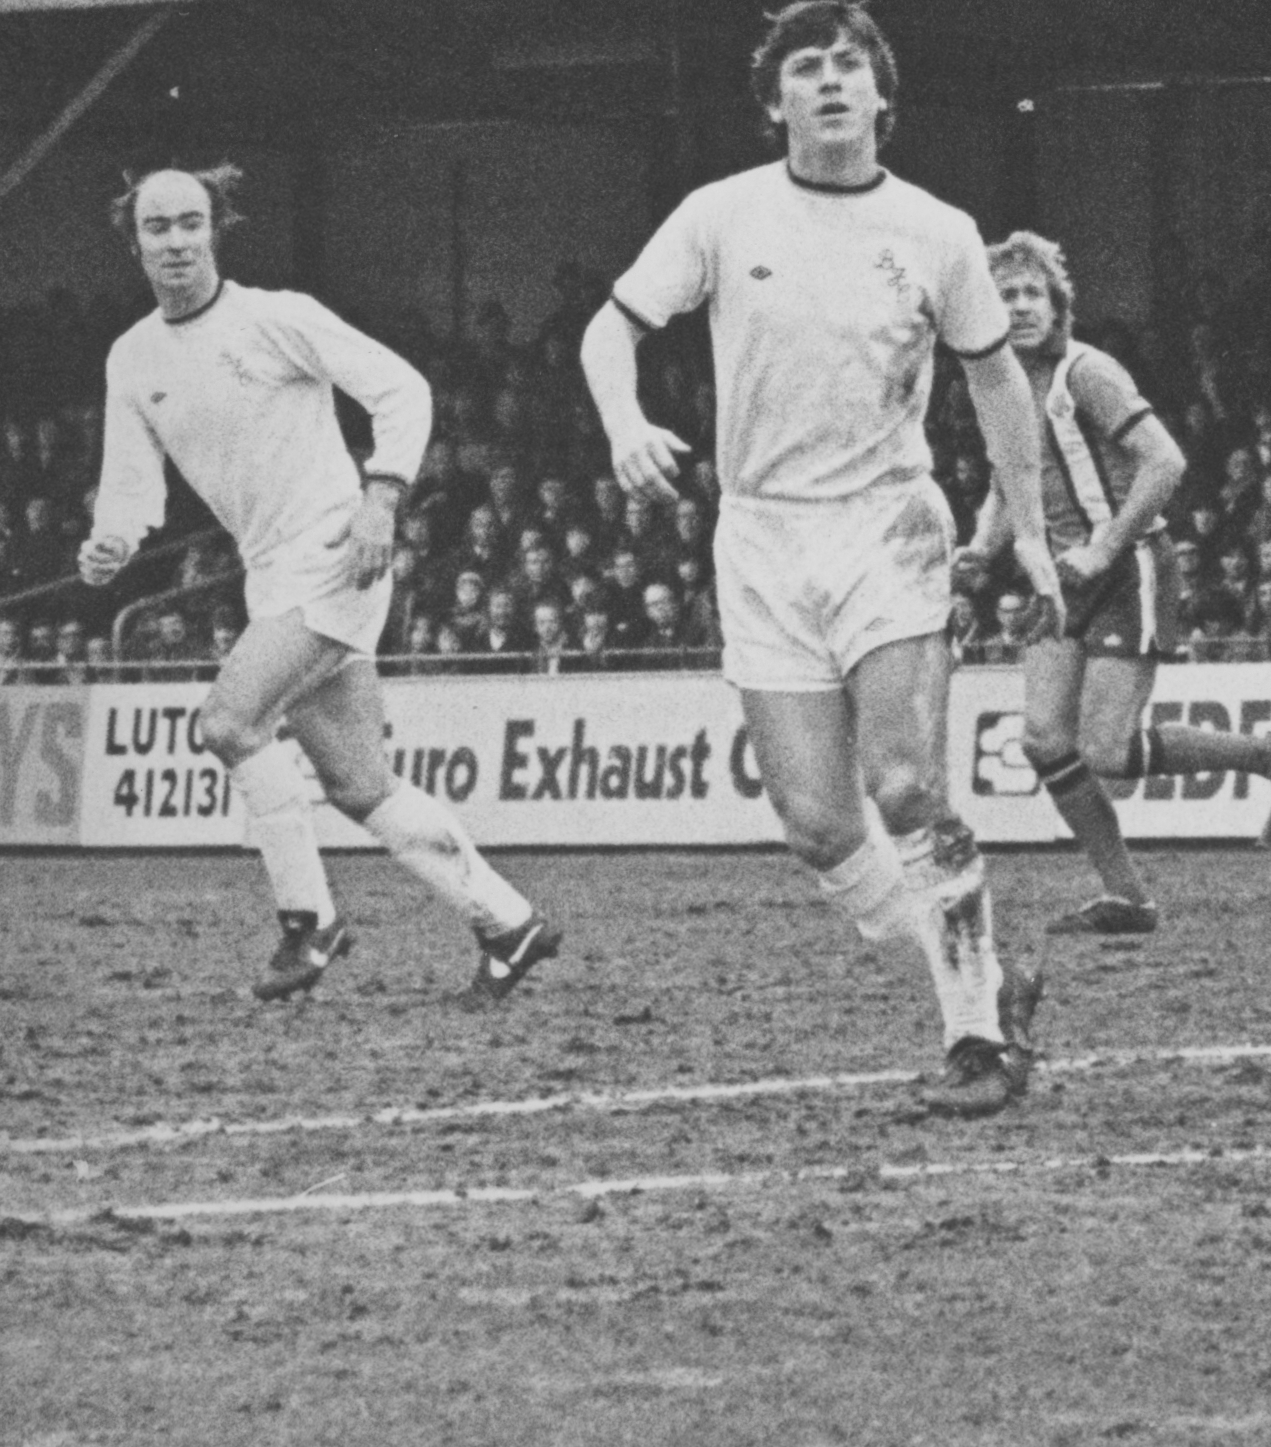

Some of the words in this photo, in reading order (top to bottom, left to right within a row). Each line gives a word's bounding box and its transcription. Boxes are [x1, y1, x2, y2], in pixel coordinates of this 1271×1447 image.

[105, 707, 207, 756] LUTO
[382, 721, 479, 803] uro
[498, 717, 712, 802] Exhaust
